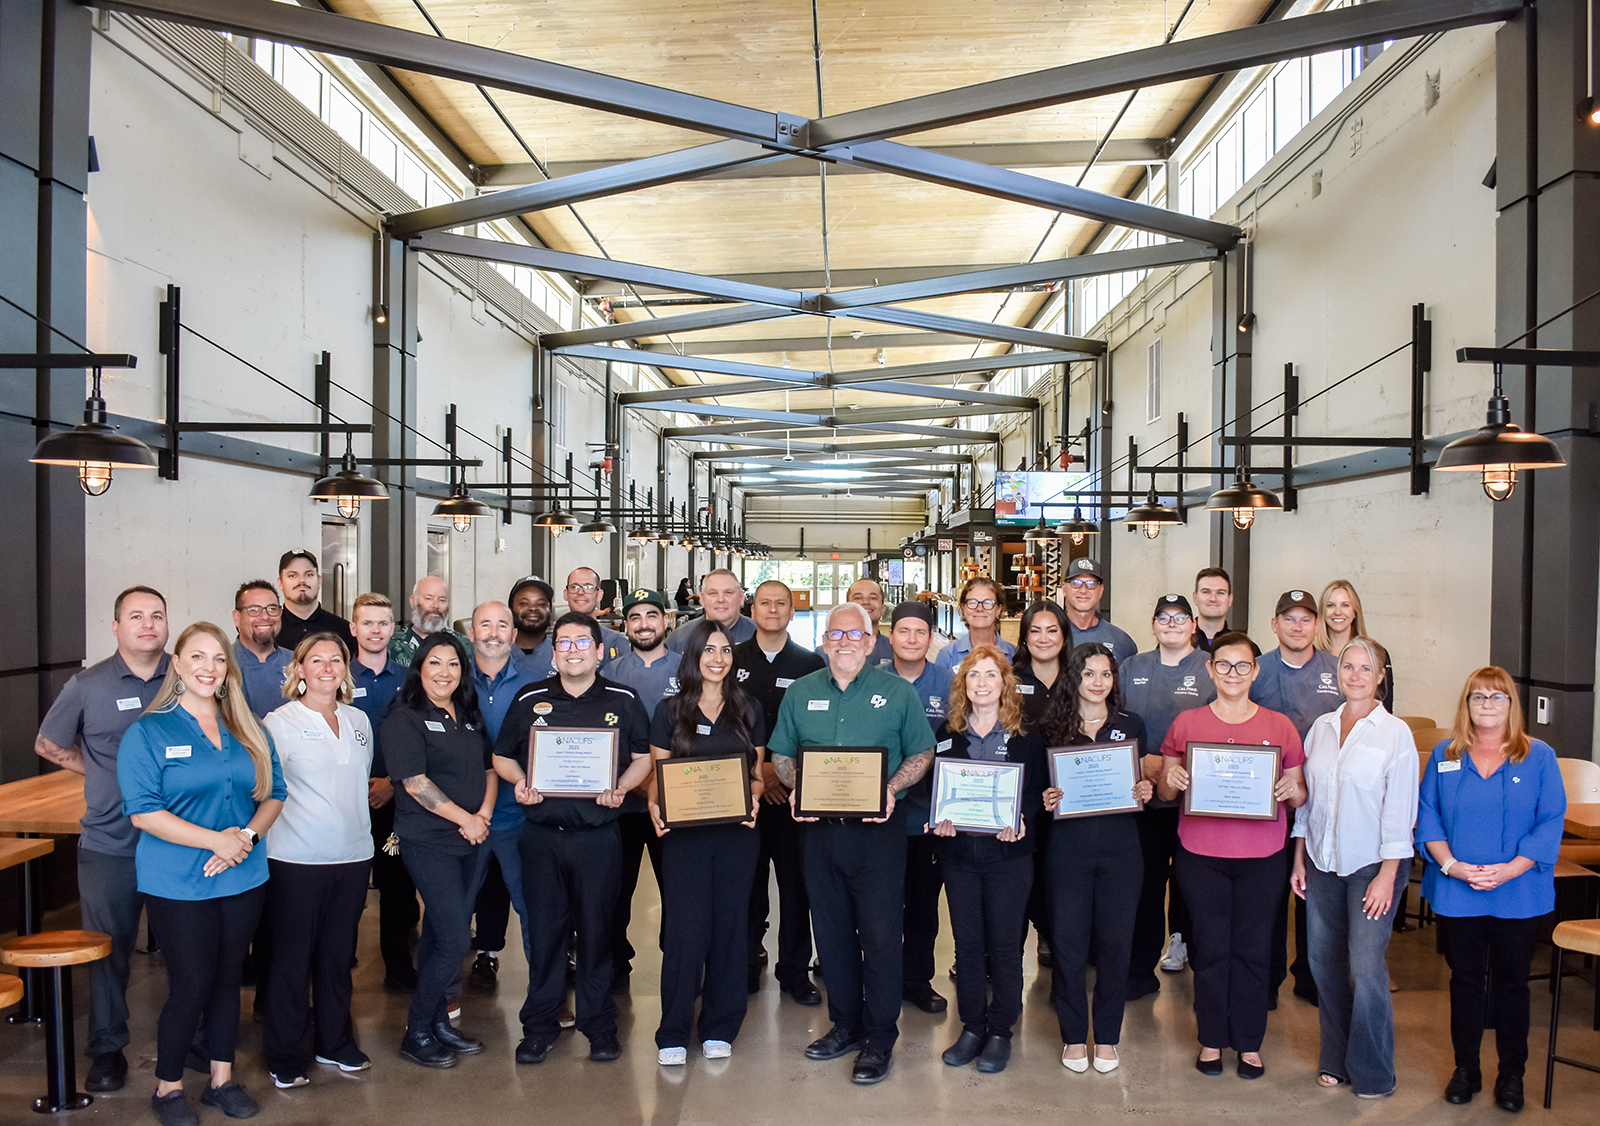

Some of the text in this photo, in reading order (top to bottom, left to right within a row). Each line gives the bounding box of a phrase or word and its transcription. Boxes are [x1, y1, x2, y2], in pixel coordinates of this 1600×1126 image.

[562, 737, 593, 745] NACUFS
[1081, 754, 1112, 763] NACUFS
[1221, 756, 1253, 764] NACUFS
